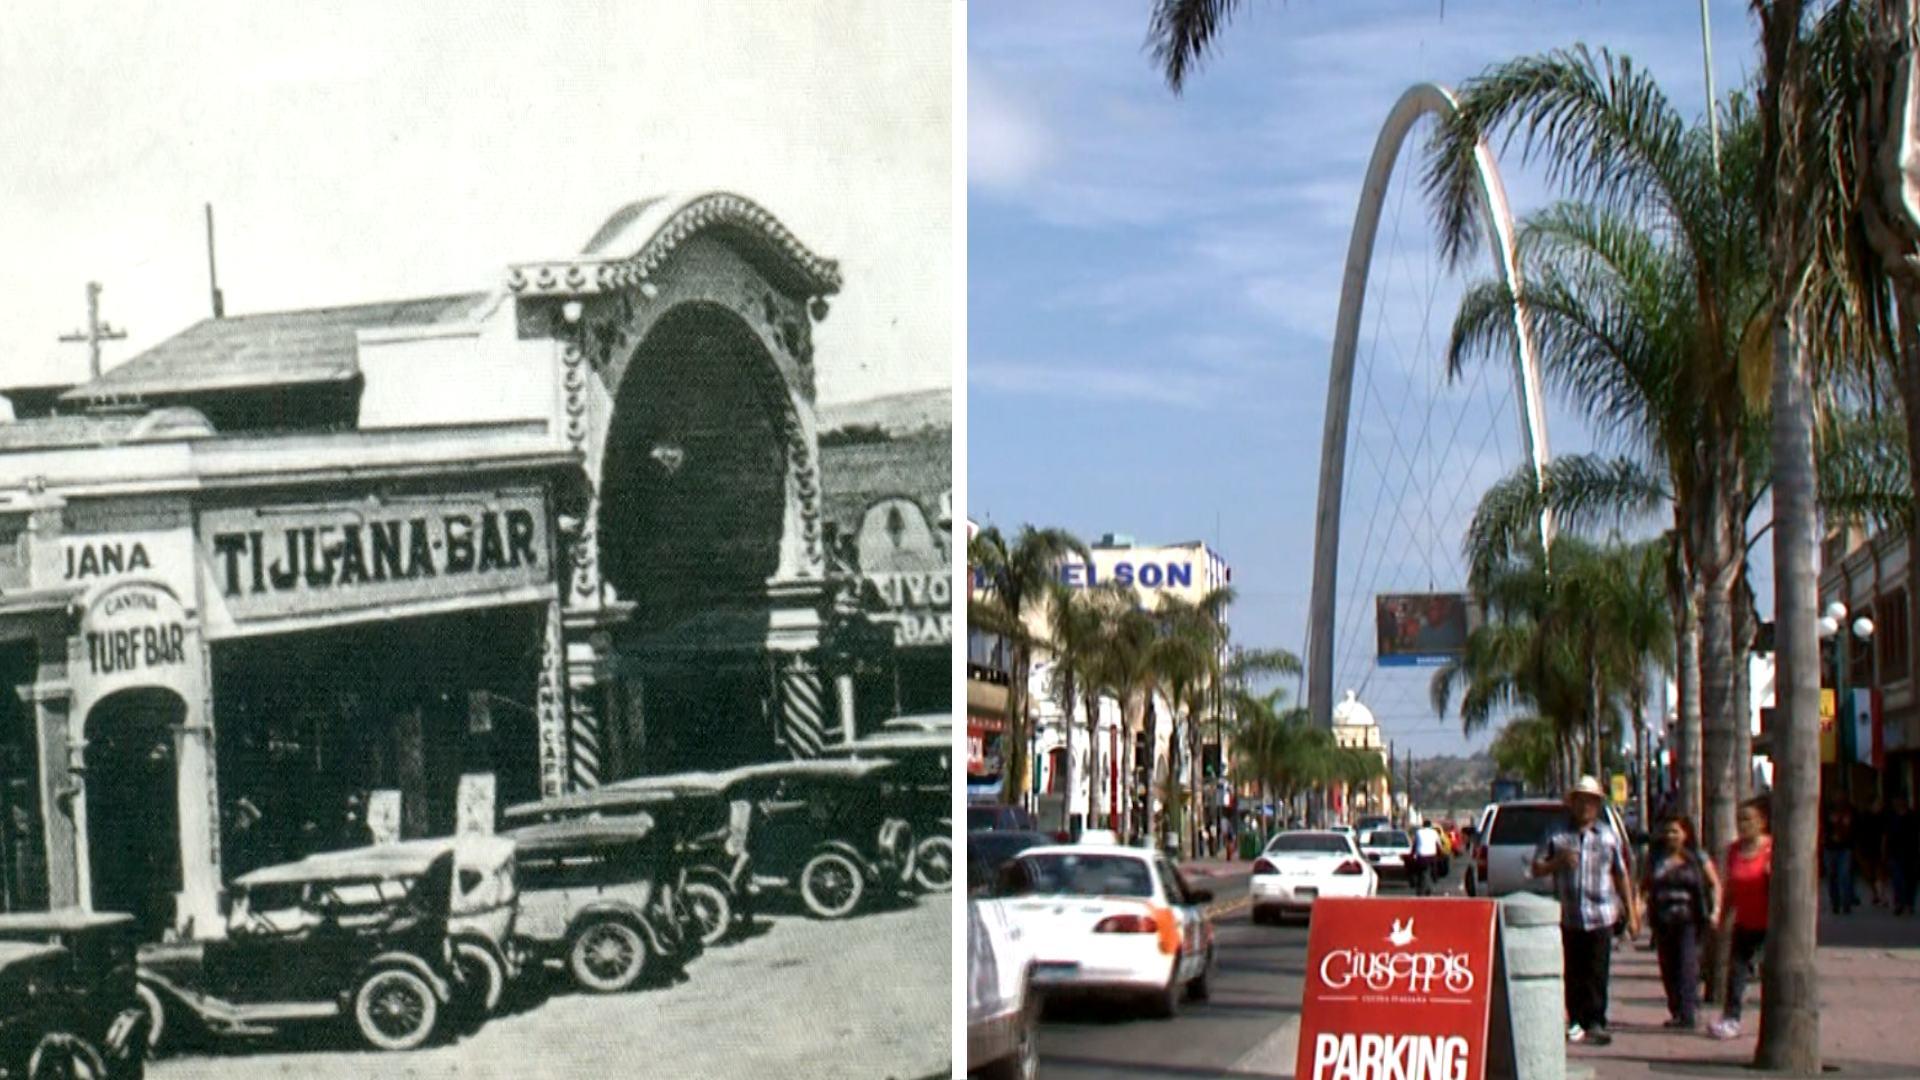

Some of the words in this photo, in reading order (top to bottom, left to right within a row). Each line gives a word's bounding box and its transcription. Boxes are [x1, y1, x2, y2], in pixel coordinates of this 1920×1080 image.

[64, 542, 150, 580] JANA
[443, 508, 537, 575] BAR
[1052, 562, 1192, 588] ELSON
[87, 627, 140, 675] TURF
[144, 621, 185, 667] BAR
[1313, 1033, 1469, 1080] PARKING
